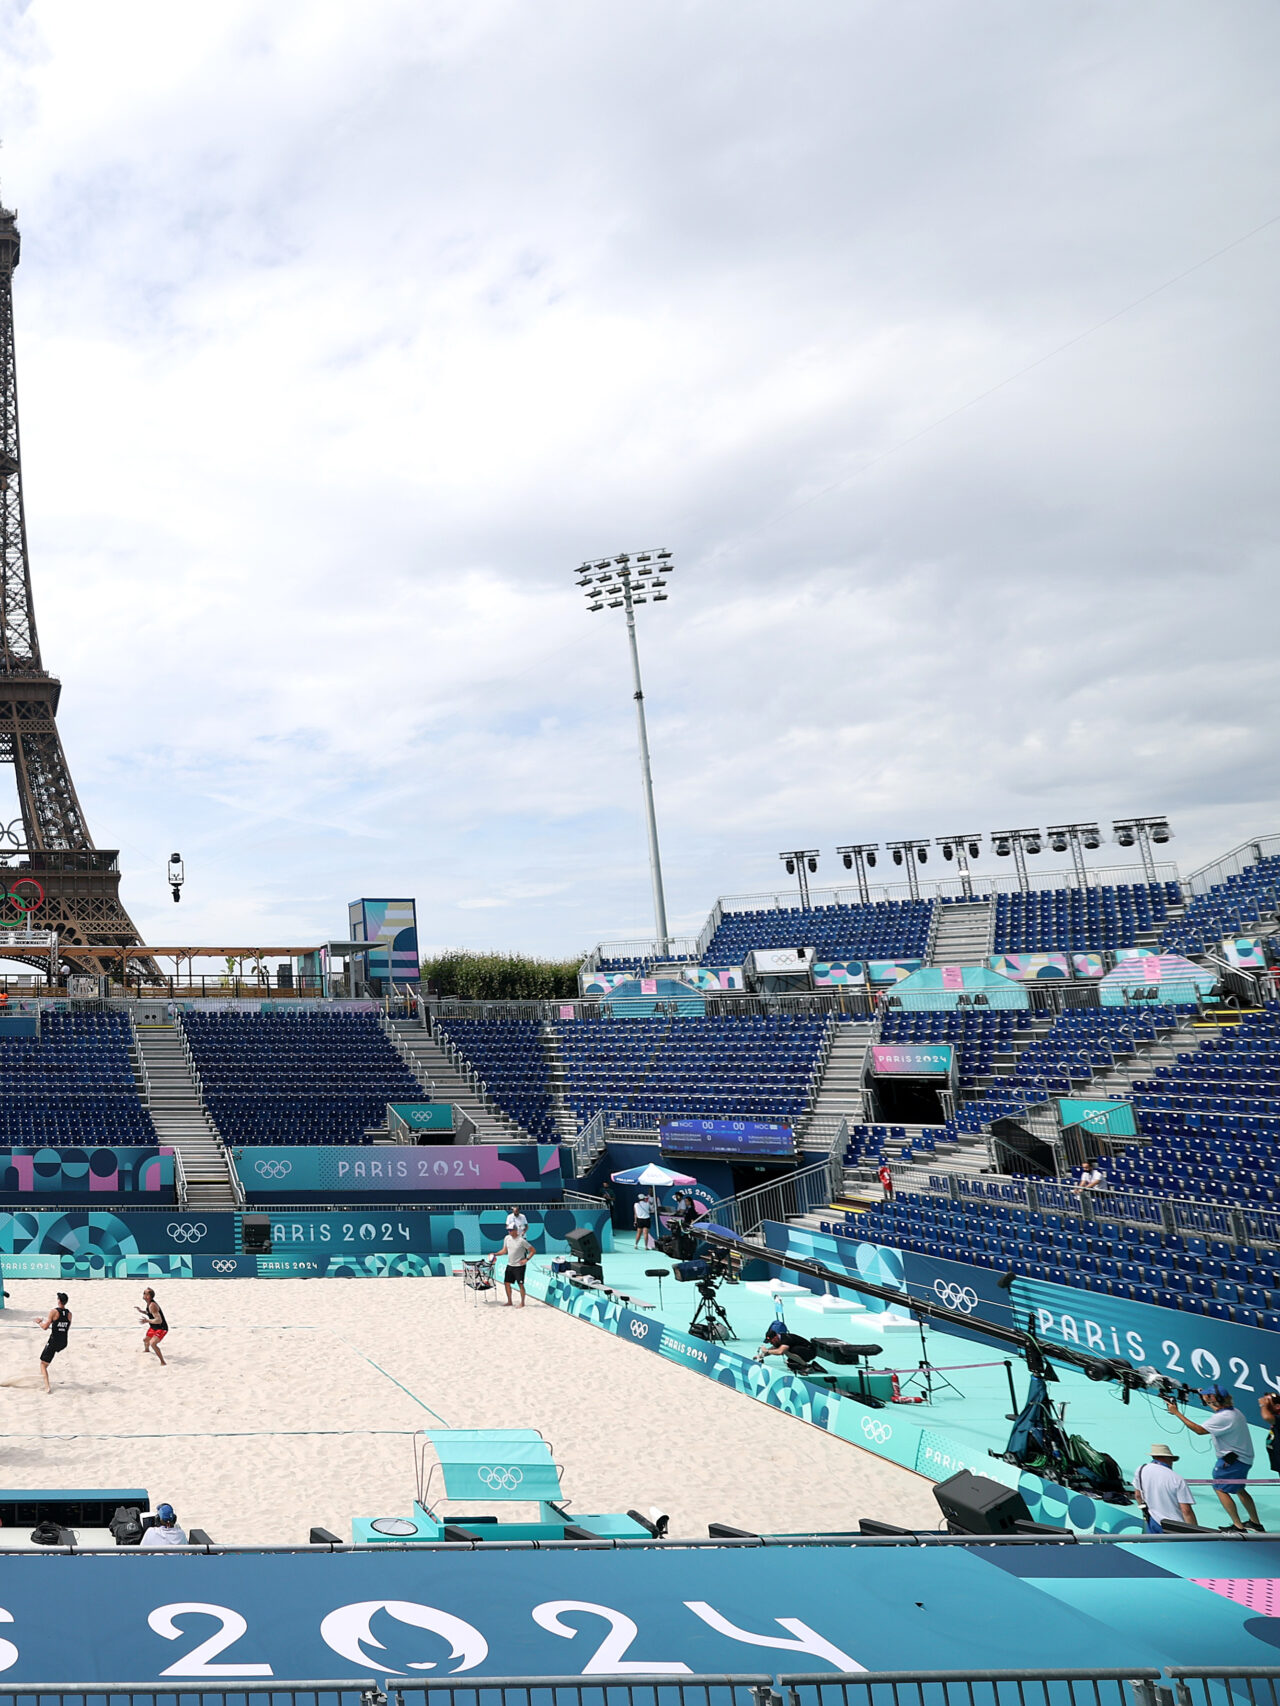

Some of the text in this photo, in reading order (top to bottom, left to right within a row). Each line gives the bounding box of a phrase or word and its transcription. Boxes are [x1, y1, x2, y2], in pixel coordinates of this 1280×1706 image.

[914, 1055, 947, 1063] 2024
[702, 1121, 714, 1130] 00
[733, 1122, 745, 1131] 00
[417, 1160, 480, 1177] 2024
[342, 1223, 410, 1241] 2024
[292, 1262, 318, 1270] 2024
[686, 1346, 708, 1363] 2024
[147, 1600, 870, 1675] 2024
